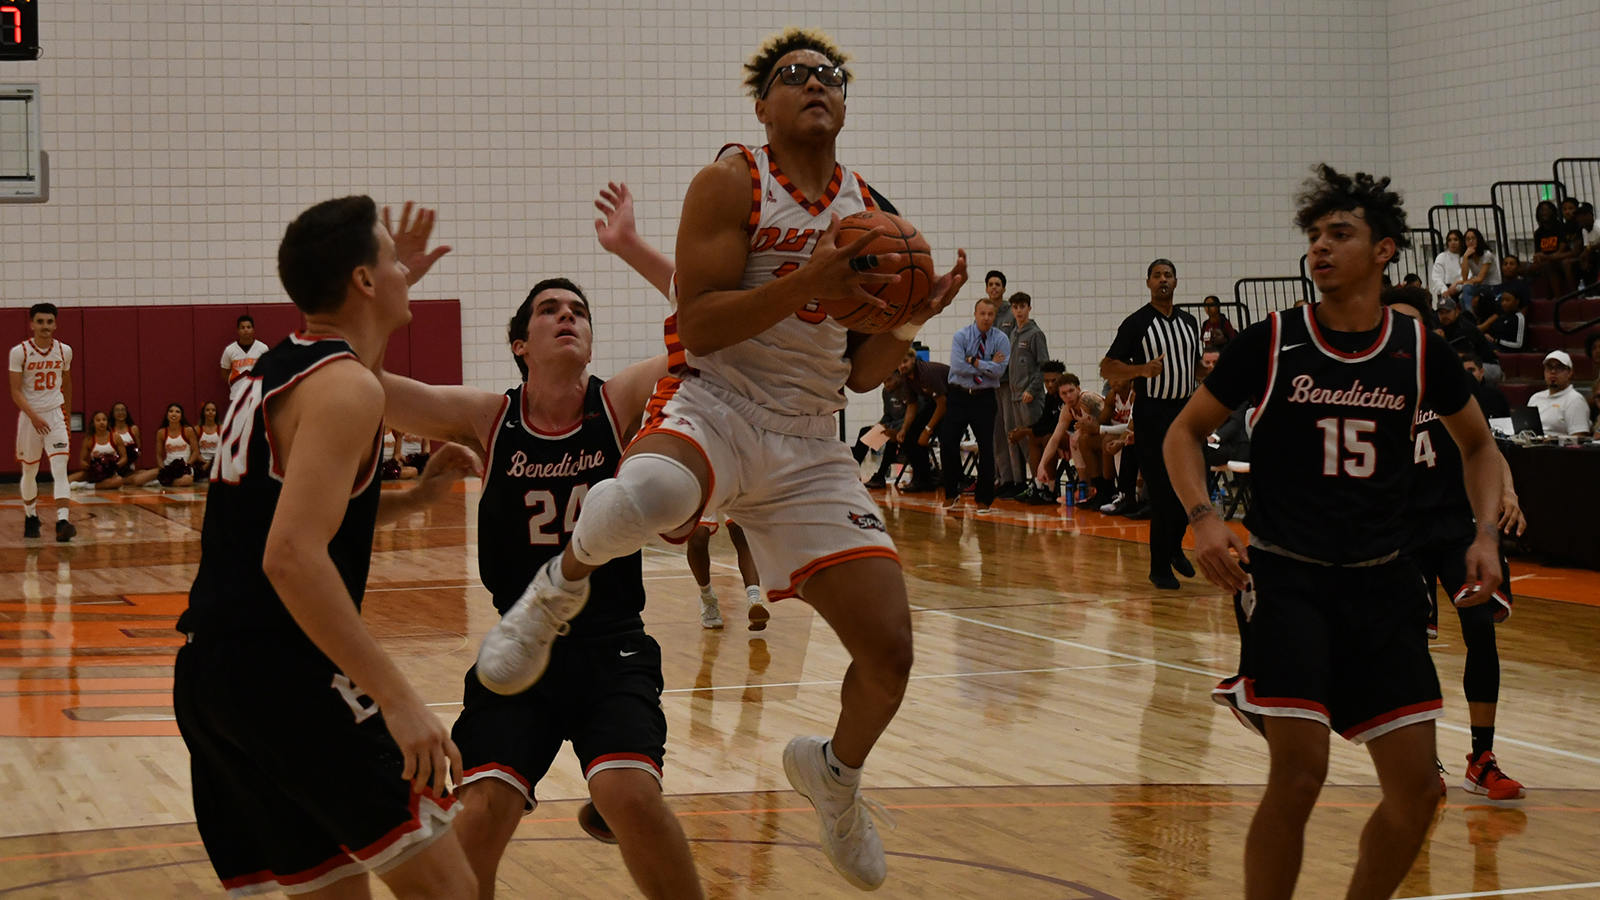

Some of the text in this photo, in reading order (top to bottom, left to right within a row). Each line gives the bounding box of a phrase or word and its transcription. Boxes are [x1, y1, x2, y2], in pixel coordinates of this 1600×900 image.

[0, 6, 22, 44] 7
[34, 371, 57, 391] 20
[1287, 374, 1406, 411] Benedictine
[1316, 416, 1377, 479] 15
[1413, 429, 1437, 469] 4
[523, 481, 590, 546] 24
